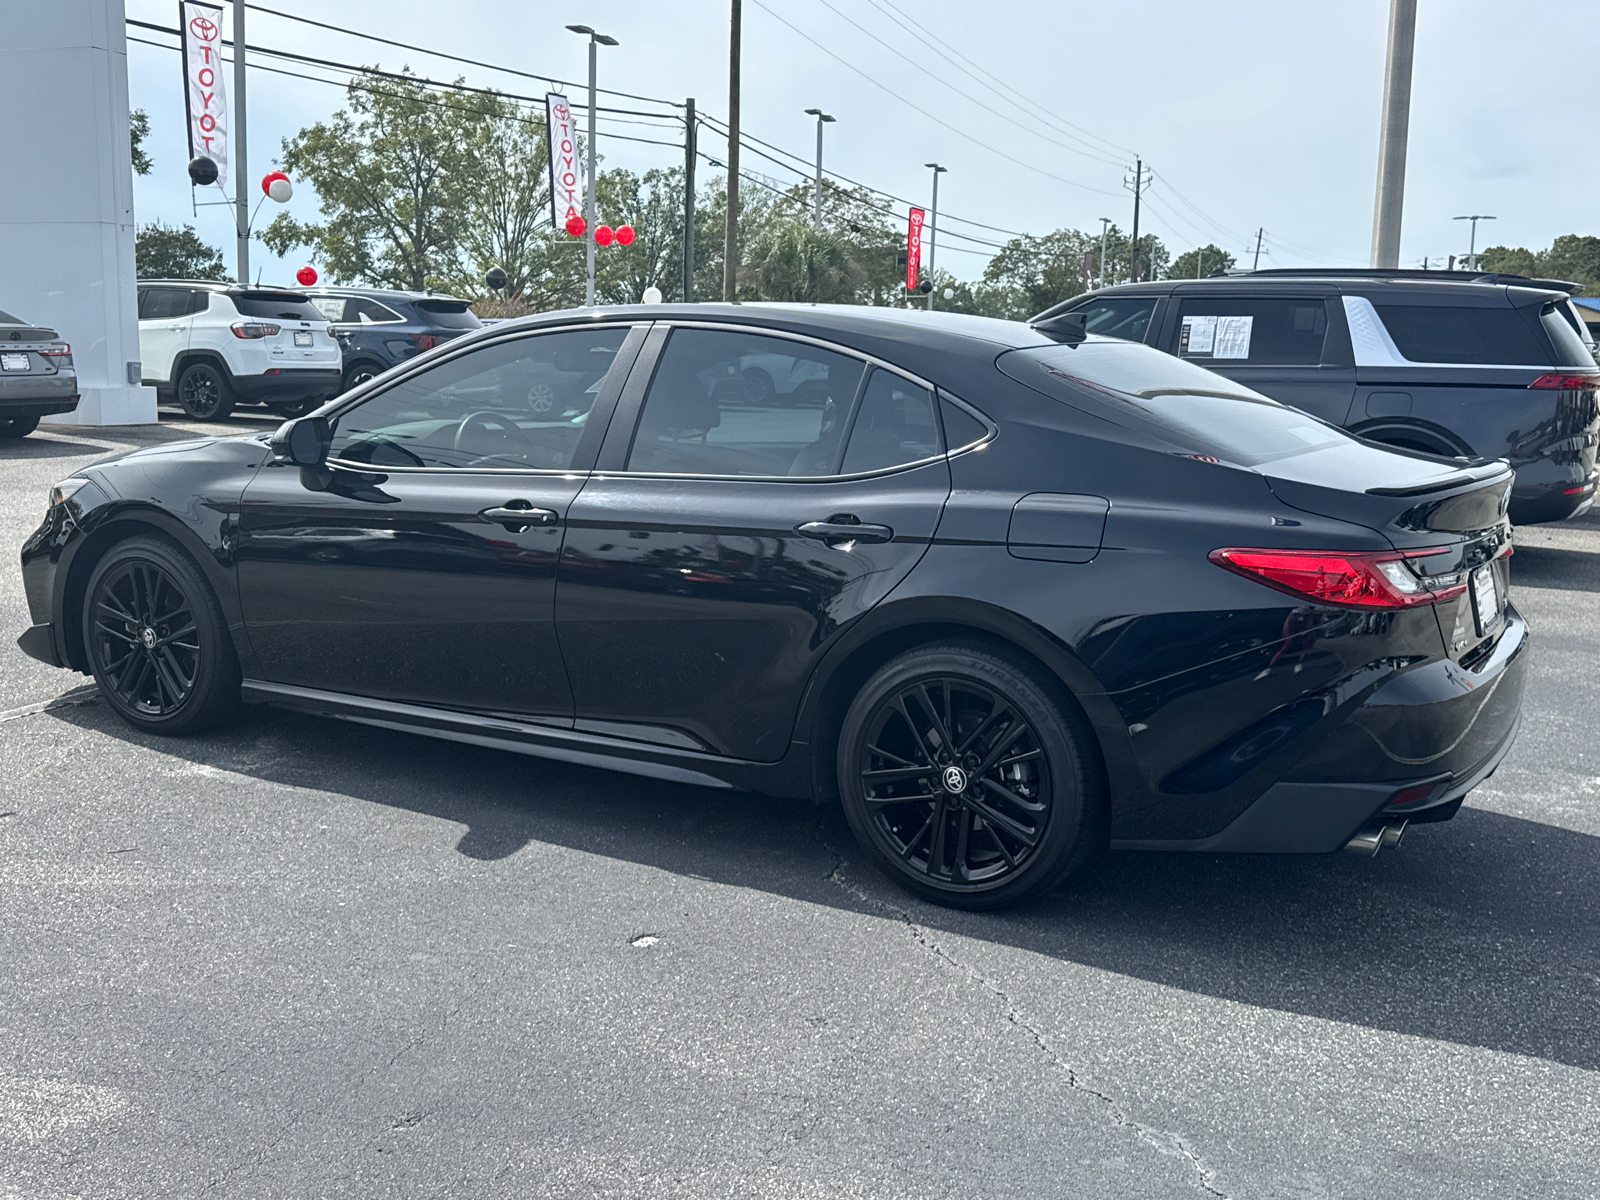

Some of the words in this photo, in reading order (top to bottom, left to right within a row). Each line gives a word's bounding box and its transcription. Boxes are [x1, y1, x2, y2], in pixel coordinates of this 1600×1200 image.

[198, 45, 215, 154] TOYOT
[560, 123, 577, 219] TOYOTA
[969, 659, 1048, 723] TURANZA
